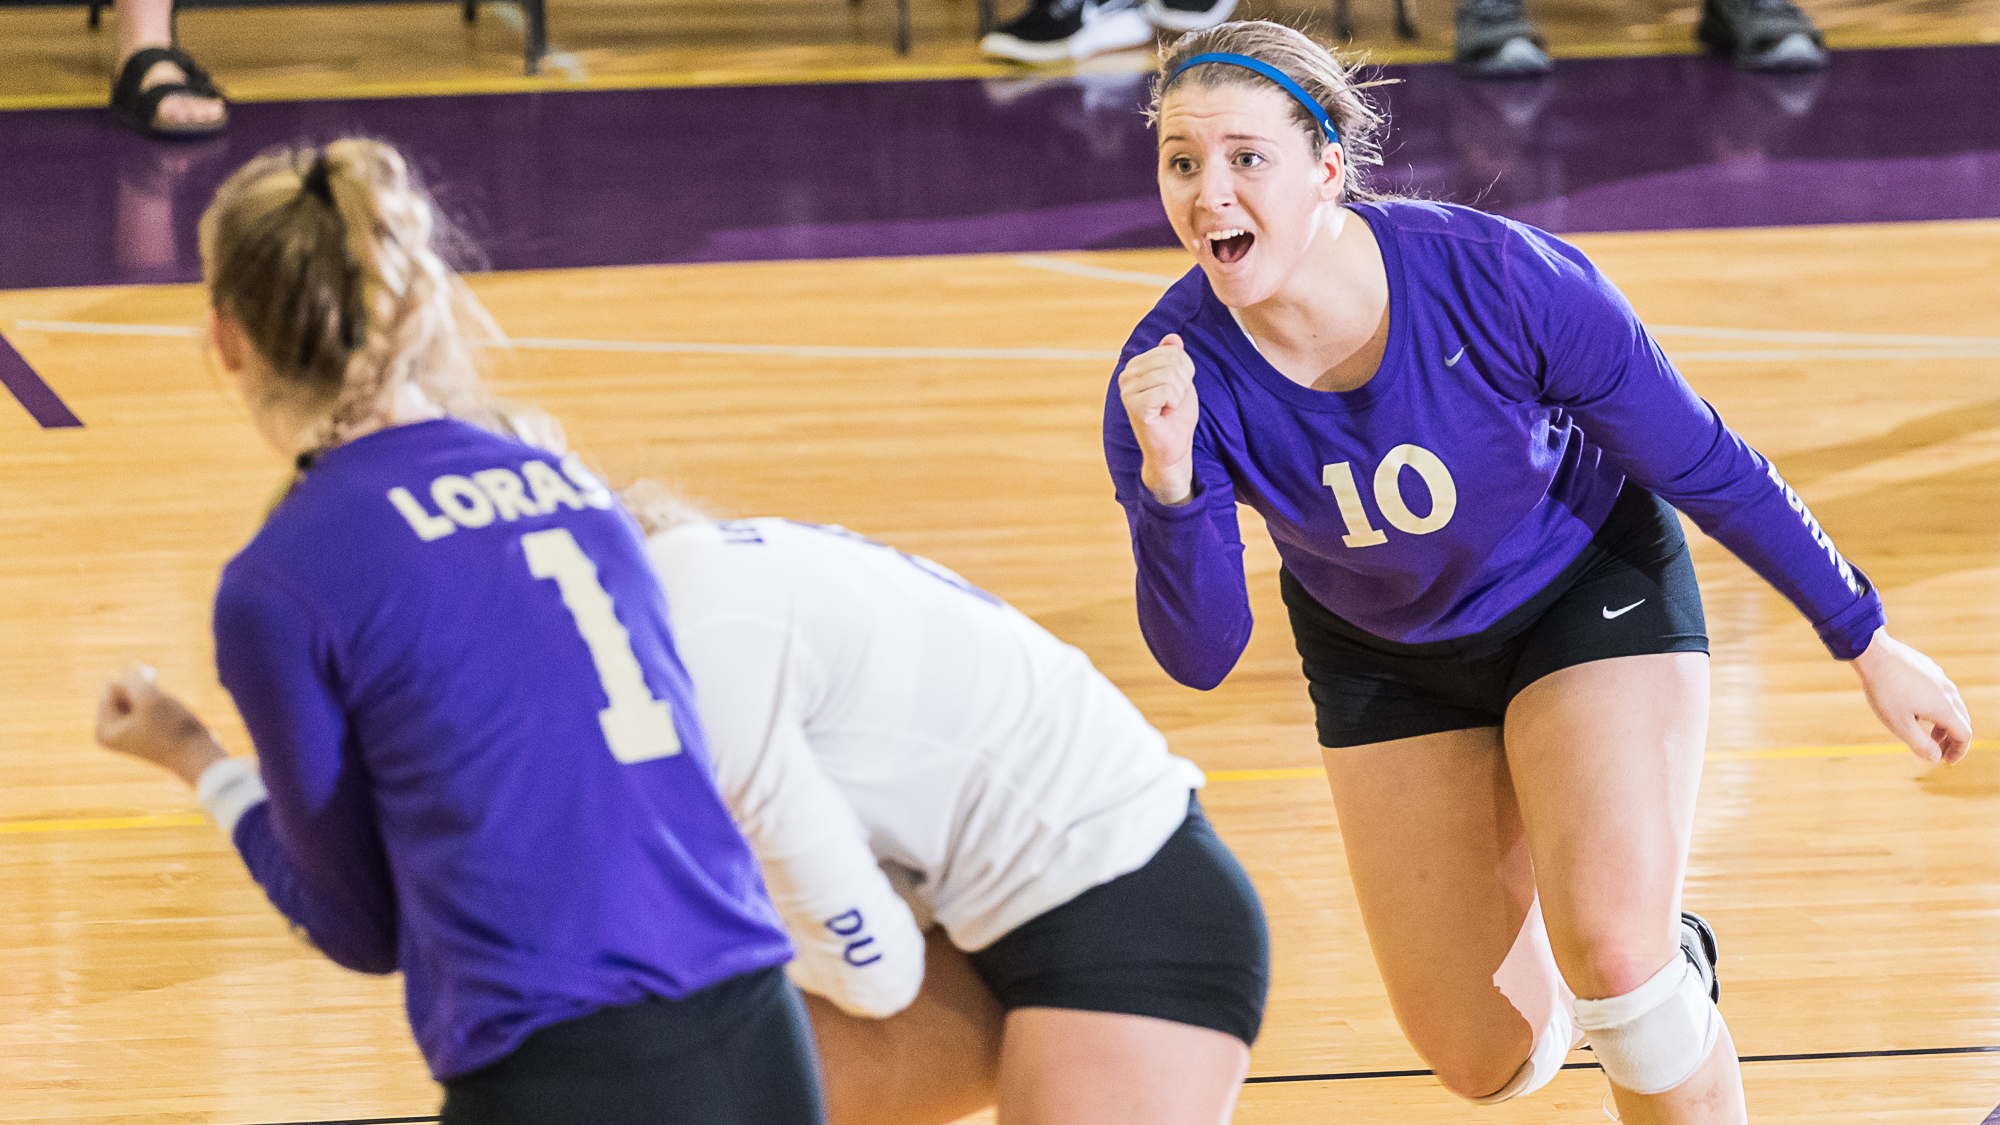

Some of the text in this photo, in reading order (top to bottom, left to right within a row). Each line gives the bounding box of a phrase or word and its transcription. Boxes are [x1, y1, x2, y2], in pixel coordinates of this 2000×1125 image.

[1322, 443, 1457, 548] 10
[521, 527, 681, 764] 1
[824, 909, 882, 967] DU
